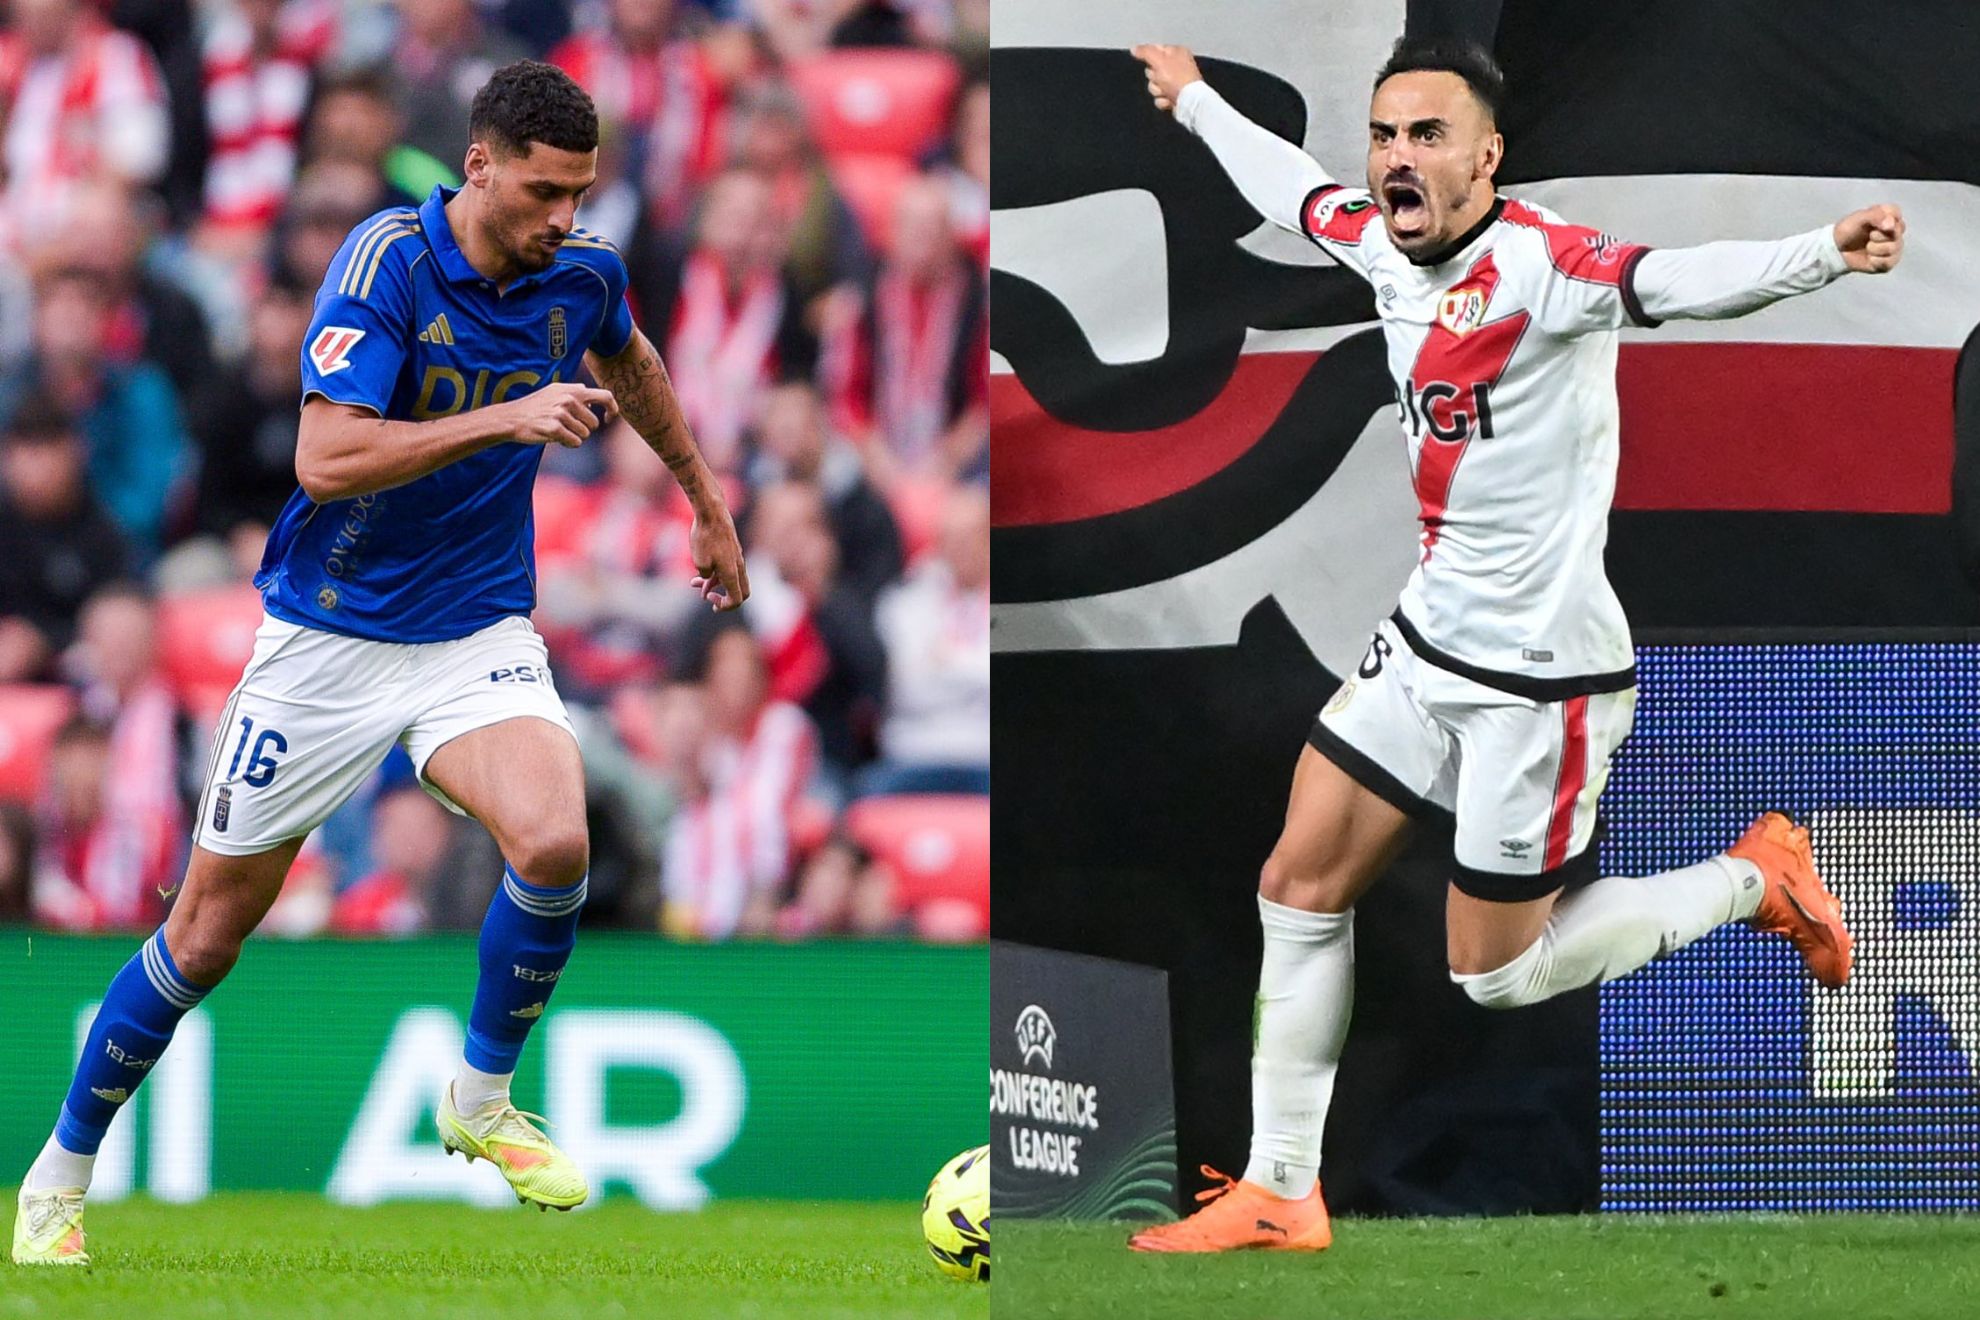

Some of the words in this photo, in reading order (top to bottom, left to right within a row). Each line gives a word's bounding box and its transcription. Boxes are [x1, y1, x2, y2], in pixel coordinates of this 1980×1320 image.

[1396, 379, 1494, 441] IGI
[226, 715, 288, 788] 16
[1009, 1125, 1079, 1176] LEAGUE
